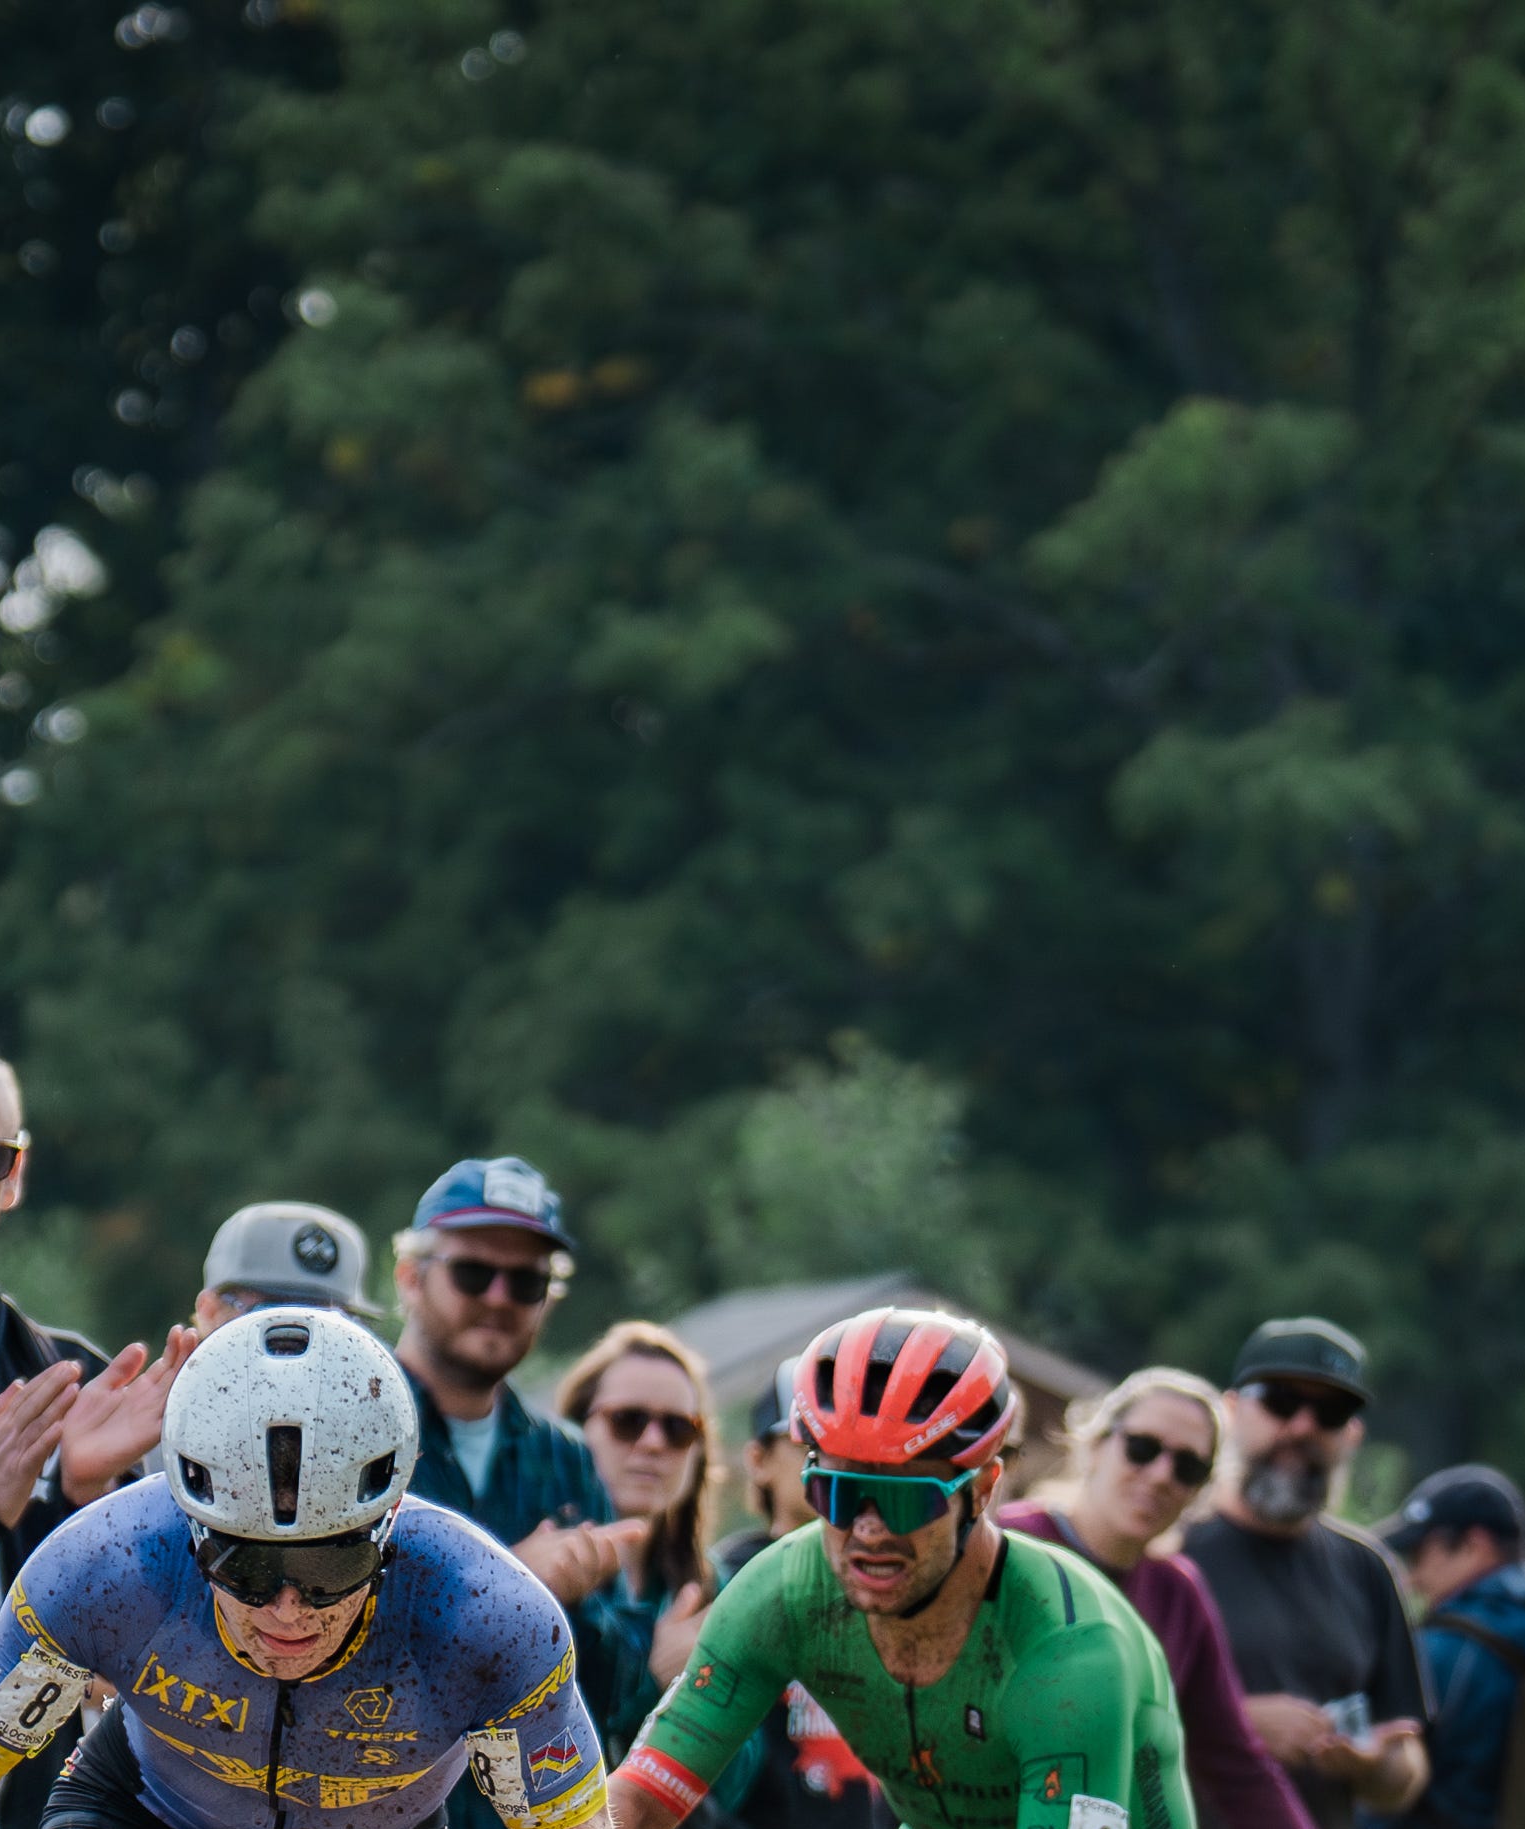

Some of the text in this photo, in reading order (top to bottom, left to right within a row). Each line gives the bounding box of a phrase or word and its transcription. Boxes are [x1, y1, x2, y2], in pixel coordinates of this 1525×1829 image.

[903, 1410, 959, 1454] CUBE
[18, 1681, 62, 1730] 8
[323, 1727, 419, 1742] TREK
[474, 1749, 497, 1797] 8
